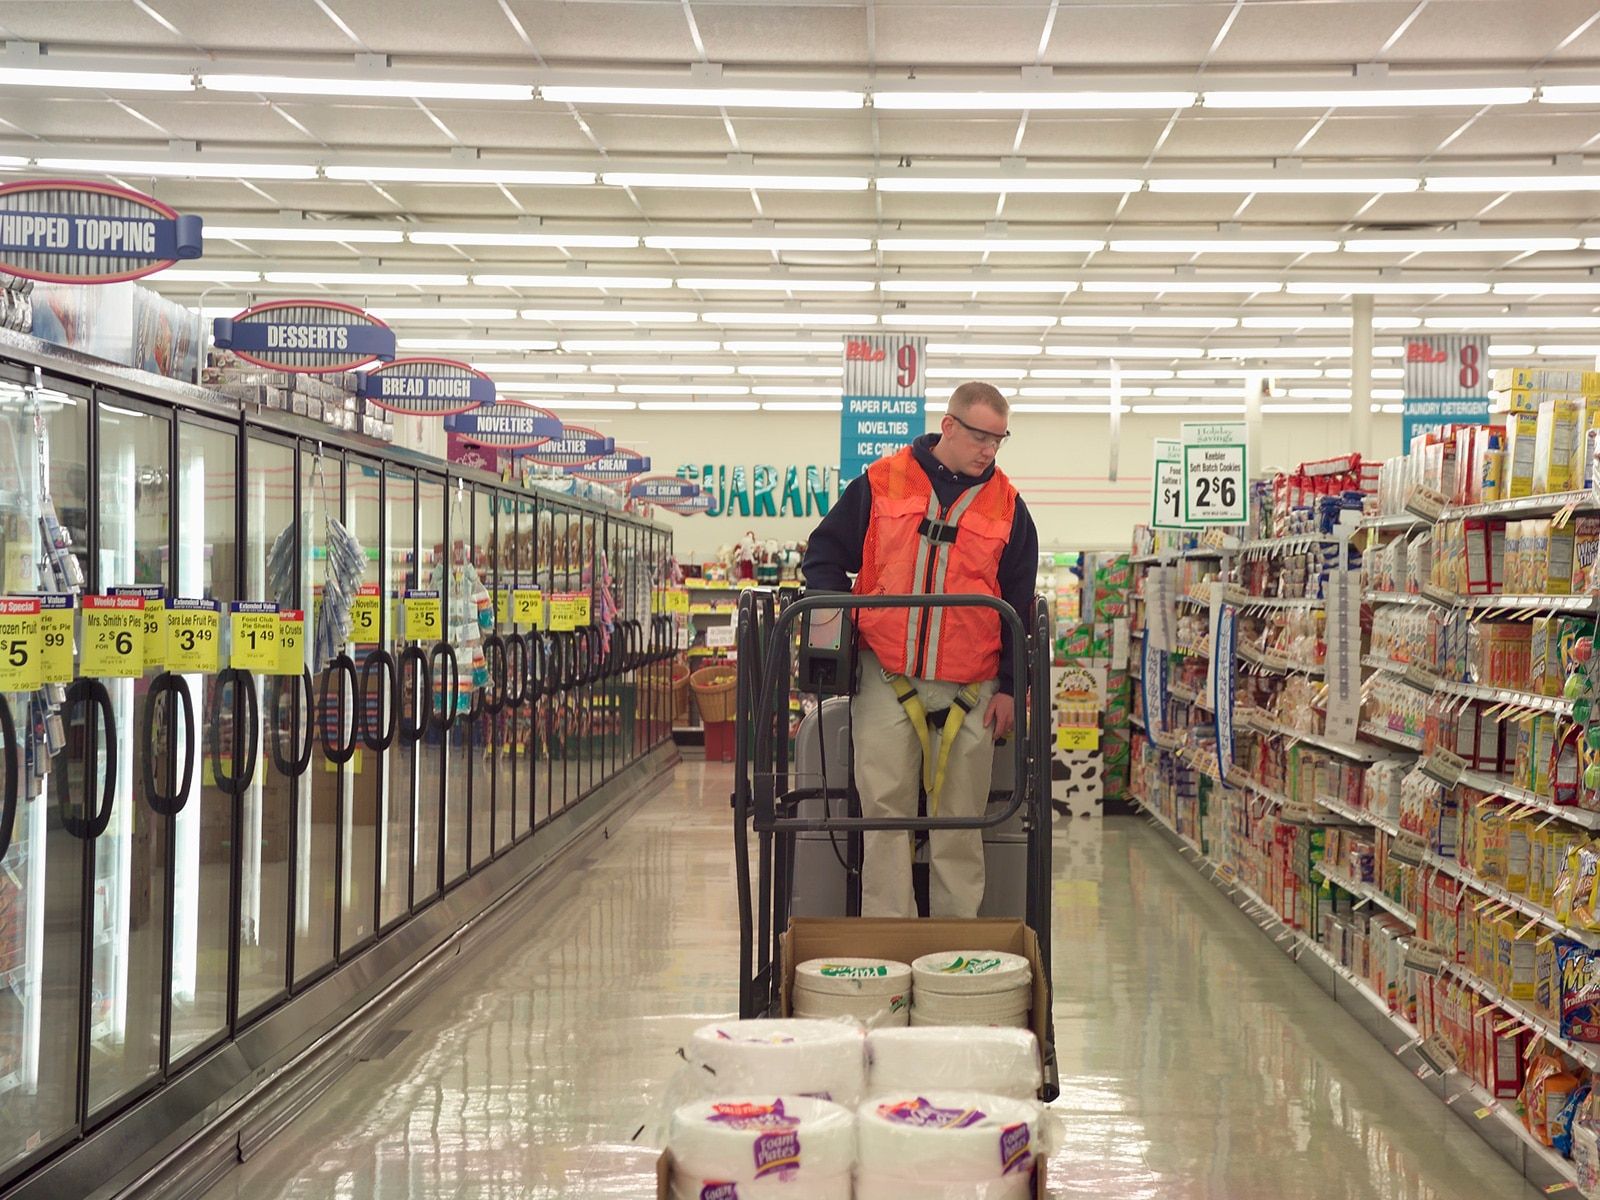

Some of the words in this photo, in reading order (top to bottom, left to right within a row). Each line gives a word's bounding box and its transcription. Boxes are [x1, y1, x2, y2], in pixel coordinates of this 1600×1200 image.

[0, 214, 69, 249] HIPPED
[75, 218, 156, 253] TOPPING
[267, 325, 348, 350] DESSERTS
[897, 344, 917, 388] 9
[1459, 344, 1479, 388] 8
[381, 377, 424, 397] BREAD
[428, 378, 471, 398] DOUGH
[850, 400, 880, 413] PAPER
[882, 401, 917, 414] PLATES
[1404, 402, 1440, 415] LAUNDRY
[1441, 402, 1488, 415] DETERGENT
[477, 417, 534, 434] NOVELTIES
[858, 421, 909, 435] NOVELTIES
[538, 440, 586, 454] NOVELTIES
[858, 442, 873, 455] ICE
[1205, 452, 1226, 460] Keebler
[599, 459, 628, 471] CREAM
[1190, 463, 1201, 472] Soft
[1202, 463, 1218, 472] Batch
[1220, 463, 1241, 472] Cookies
[646, 485, 657, 495] ICE
[658, 486, 682, 496] CREAM
[676, 464, 848, 517] UARAN
[9, 602, 34, 613] Special
[93, 597, 116, 608] Weekly
[117, 598, 140, 608] Special
[88, 614, 101, 627] Mrs.
[103, 614, 127, 627] Smith's
[129, 614, 141, 628] Pies
[168, 614, 180, 626] Sara
[182, 614, 191, 626] Lee
[421, 611, 435, 627] $5
[0, 623, 20, 635] rozen
[22, 620, 37, 636] Fruit
[99, 632, 106, 642] 2
[108, 630, 133, 655] $6
[760, 1134, 794, 1151] Foam
[757, 1146, 796, 1166] Plates
